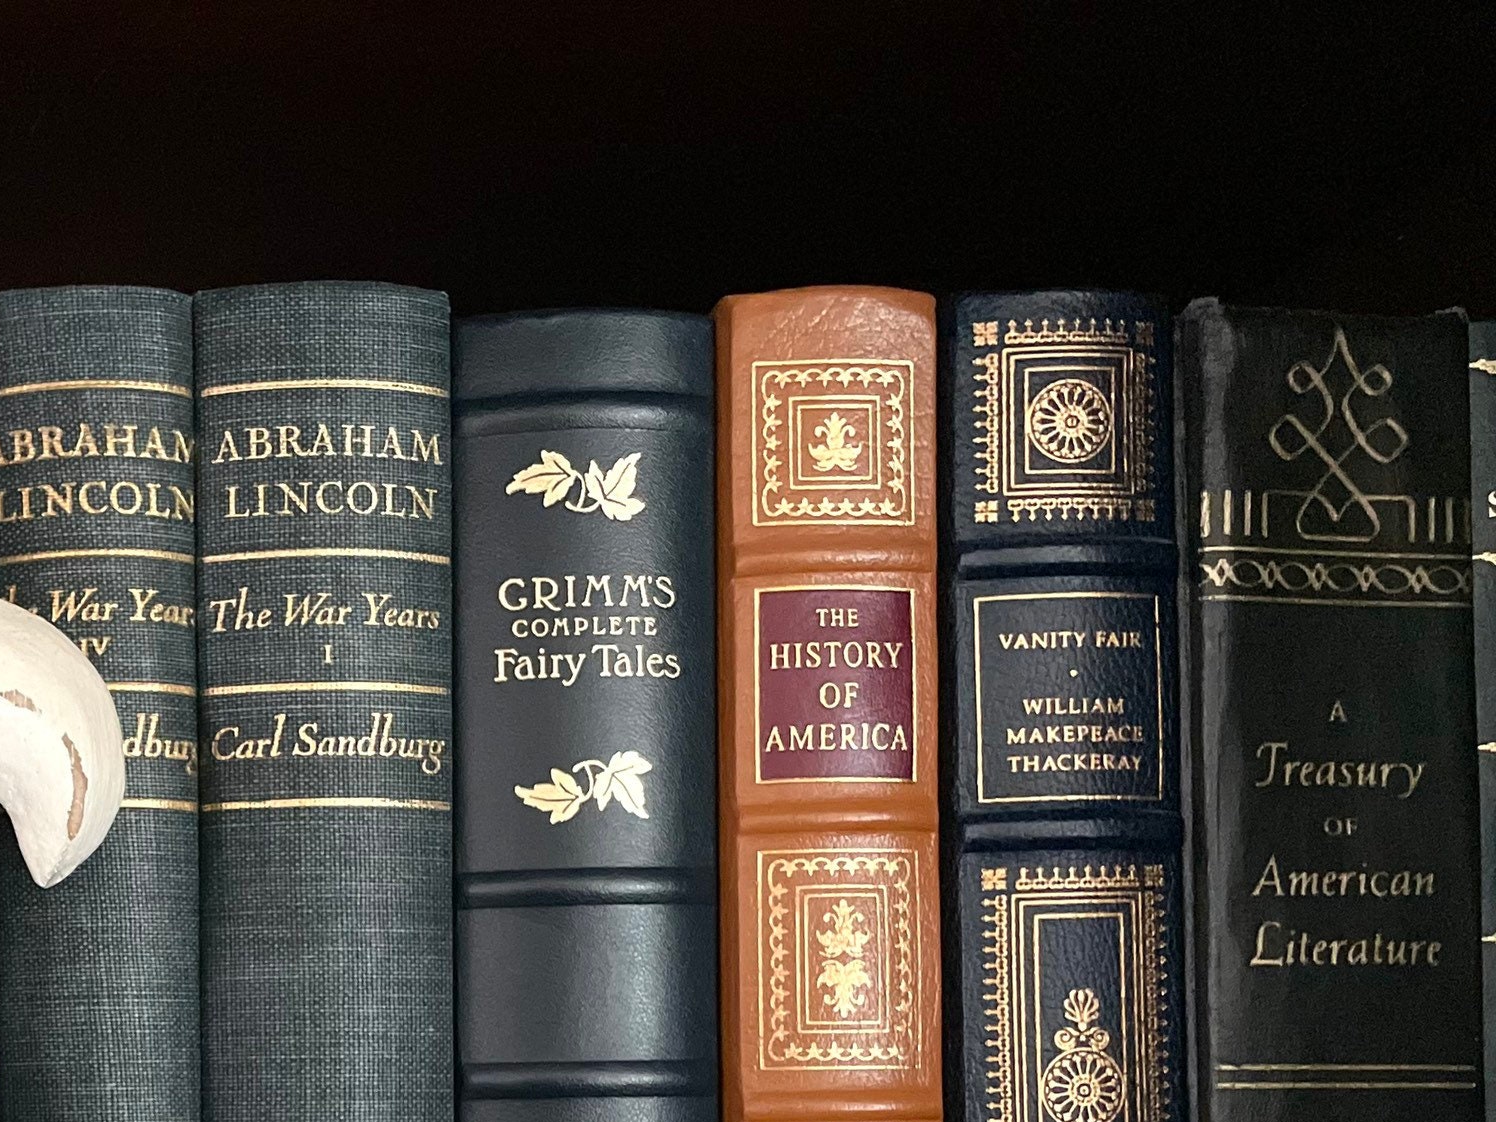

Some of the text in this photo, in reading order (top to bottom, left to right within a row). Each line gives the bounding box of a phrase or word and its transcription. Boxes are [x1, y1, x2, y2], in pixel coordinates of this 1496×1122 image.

[211, 423, 443, 466] ABRAHAM
[221, 481, 439, 520] LINCOLN
[47, 586, 119, 623] War
[497, 574, 677, 612] GRIMM'S
[209, 586, 442, 633] The War Years
[815, 607, 860, 628] THE
[511, 615, 658, 638] COMPLETE
[998, 629, 1143, 650] VANITY FAIR
[321, 643, 335, 665] I
[493, 643, 682, 687] Fairy Tales
[769, 640, 904, 670] HISTORY
[819, 681, 860, 709] OF
[1022, 697, 1125, 716] WILLIAM
[1329, 700, 1348, 723] A
[210, 711, 446, 775] Carl Sandburg
[764, 722, 908, 753] AMERICA
[1006, 724, 1145, 745] MAKEPEACE
[1006, 752, 1143, 773] THACKERAY
[1255, 741, 1427, 799] Treasury
[1323, 816, 1359, 836] OF
[1252, 853, 1436, 898] American
[1249, 920, 1443, 968] Literature
